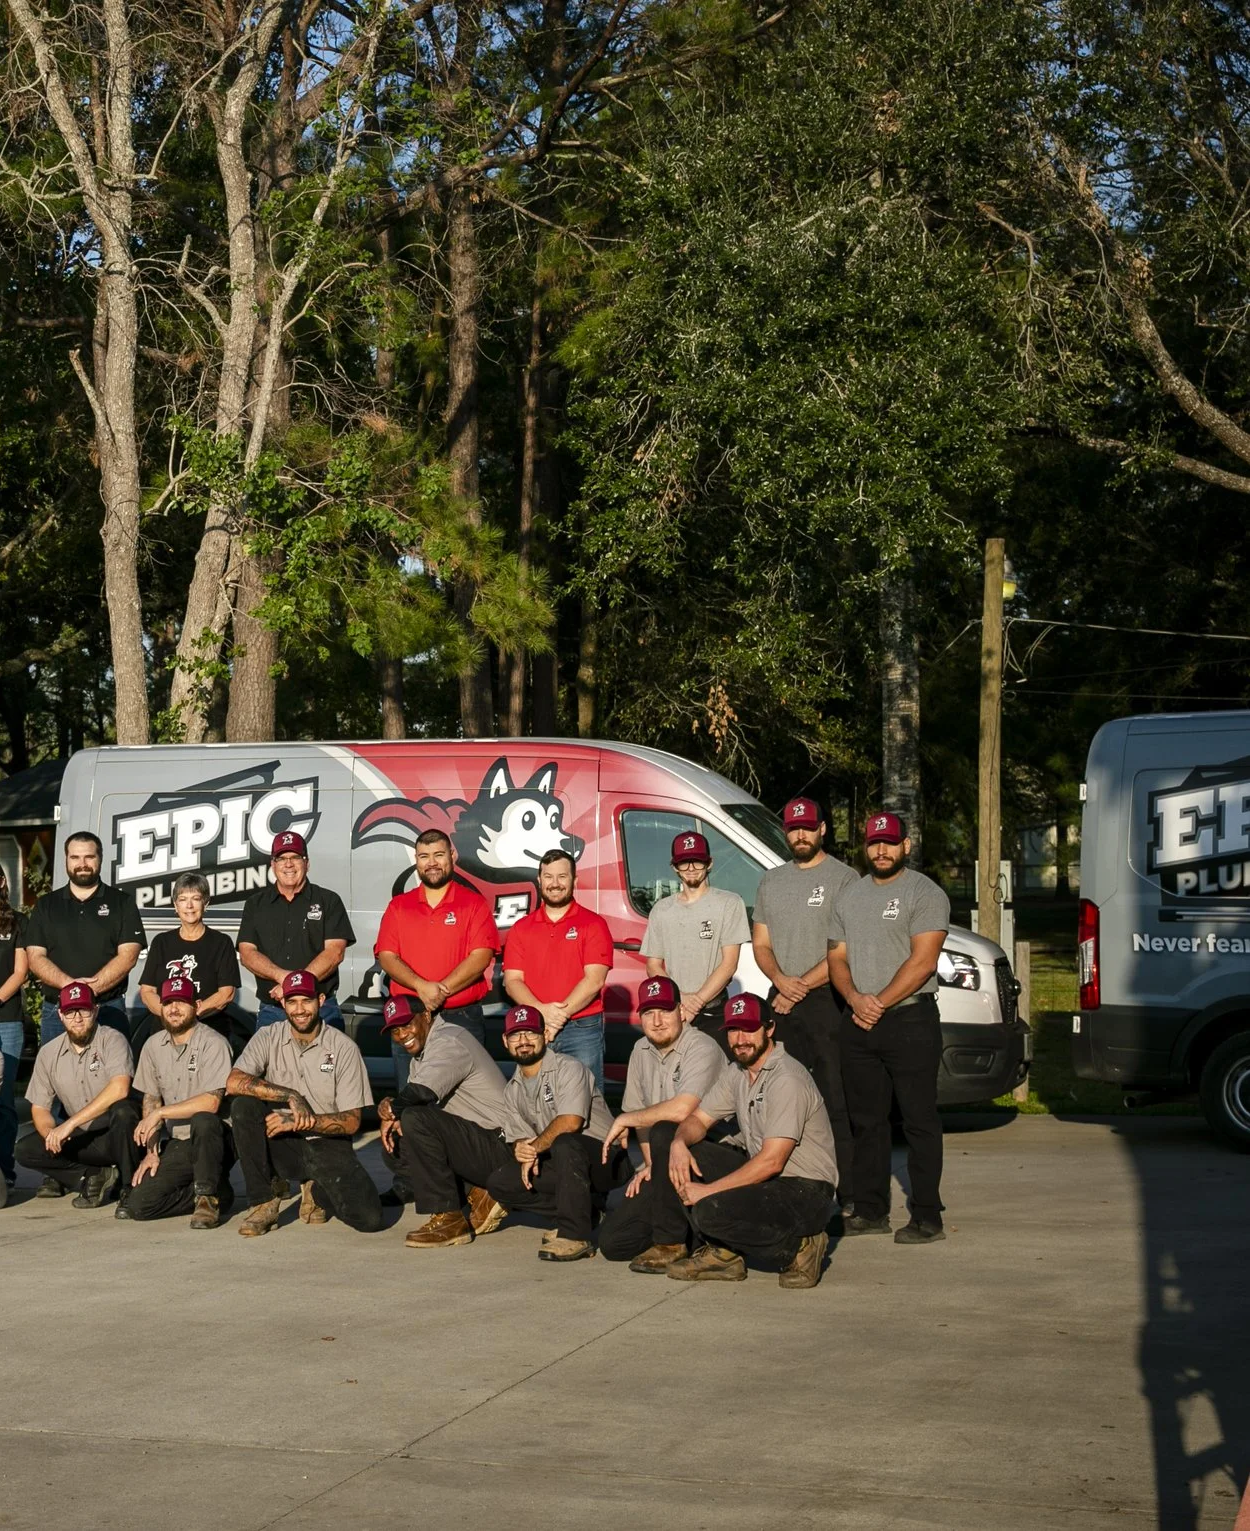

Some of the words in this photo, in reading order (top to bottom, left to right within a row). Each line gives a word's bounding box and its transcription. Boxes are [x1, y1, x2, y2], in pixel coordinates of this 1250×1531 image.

[116, 785, 314, 883] EPIC
[136, 864, 277, 909] PLBIN
[1177, 861, 1250, 897] PLU
[496, 893, 528, 929] E
[1133, 933, 1201, 952] Never
